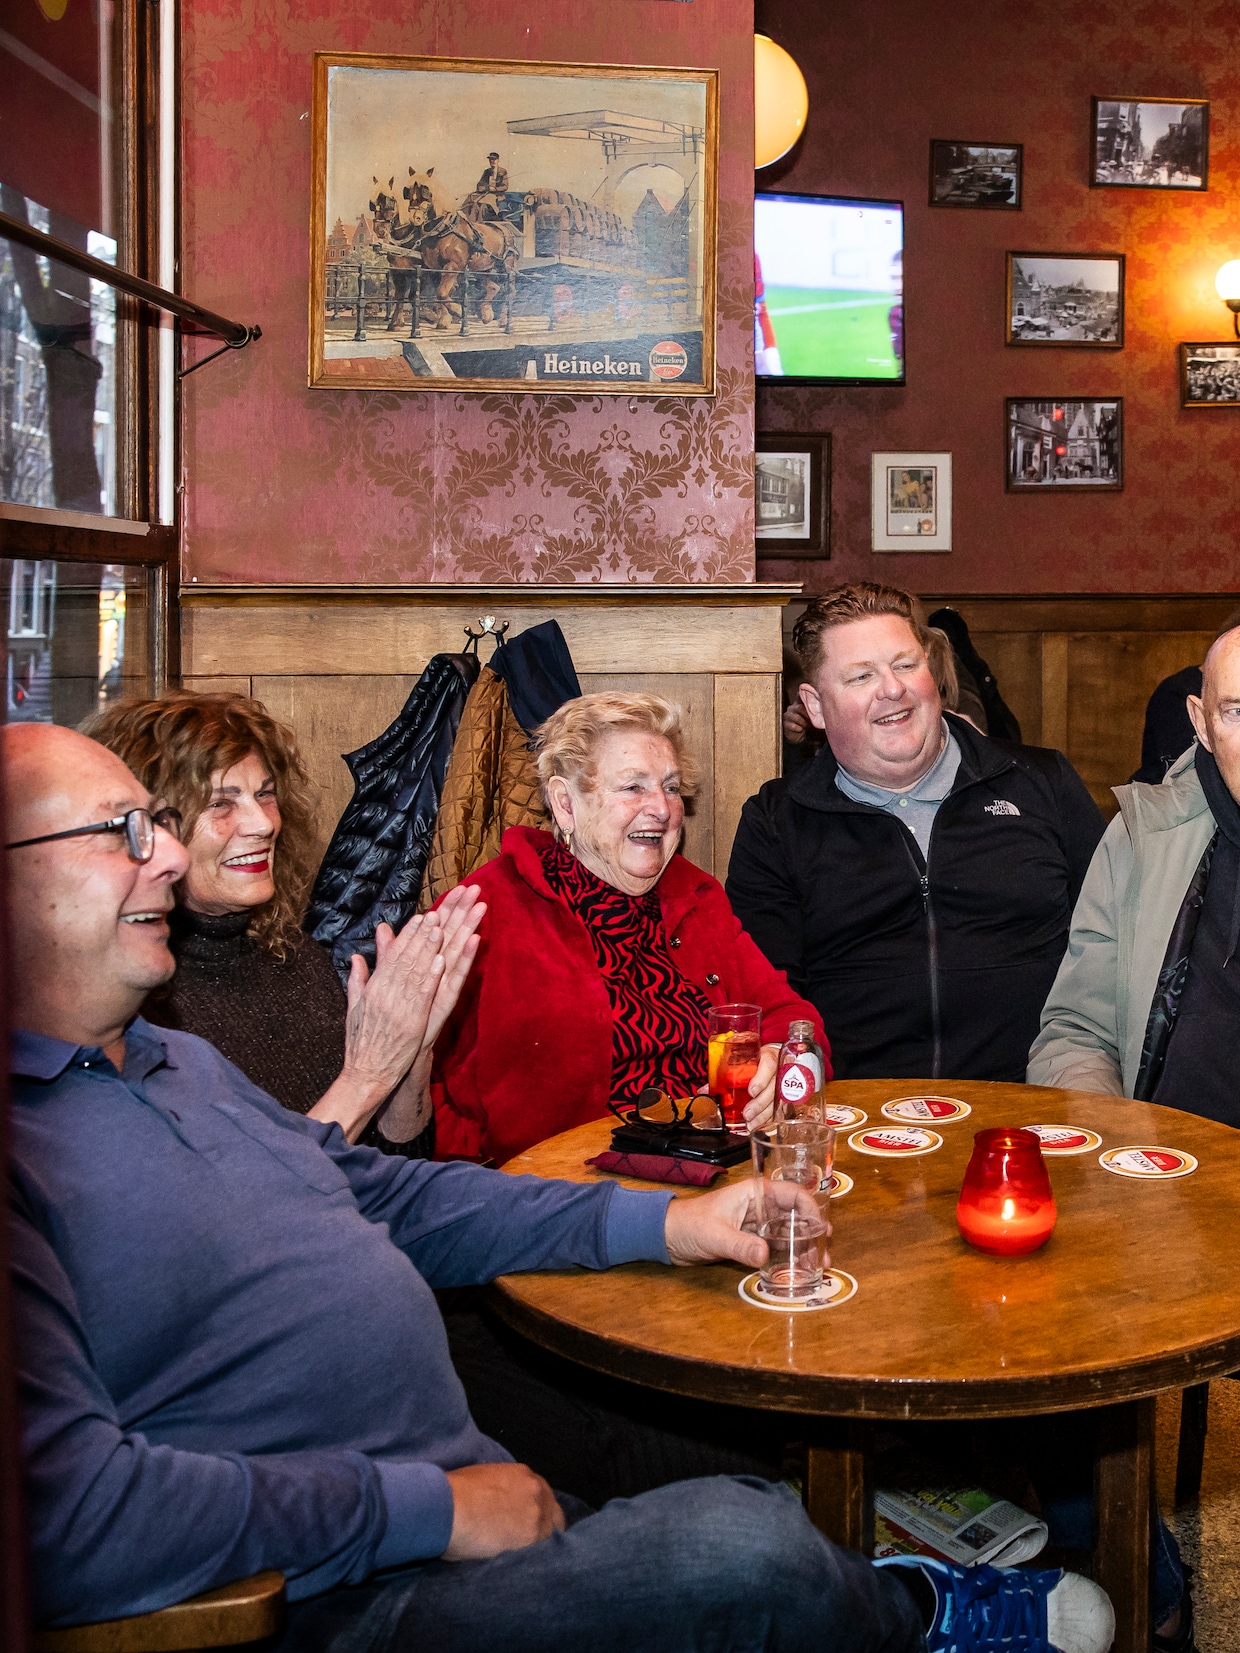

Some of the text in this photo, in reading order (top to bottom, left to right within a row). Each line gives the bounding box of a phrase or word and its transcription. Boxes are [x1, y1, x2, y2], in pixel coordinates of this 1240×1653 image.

[544, 353, 642, 376] Heineken
[652, 356, 684, 364] Heineken
[784, 1079, 804, 1089] SPA
[874, 1133, 924, 1145] AMSTEL
